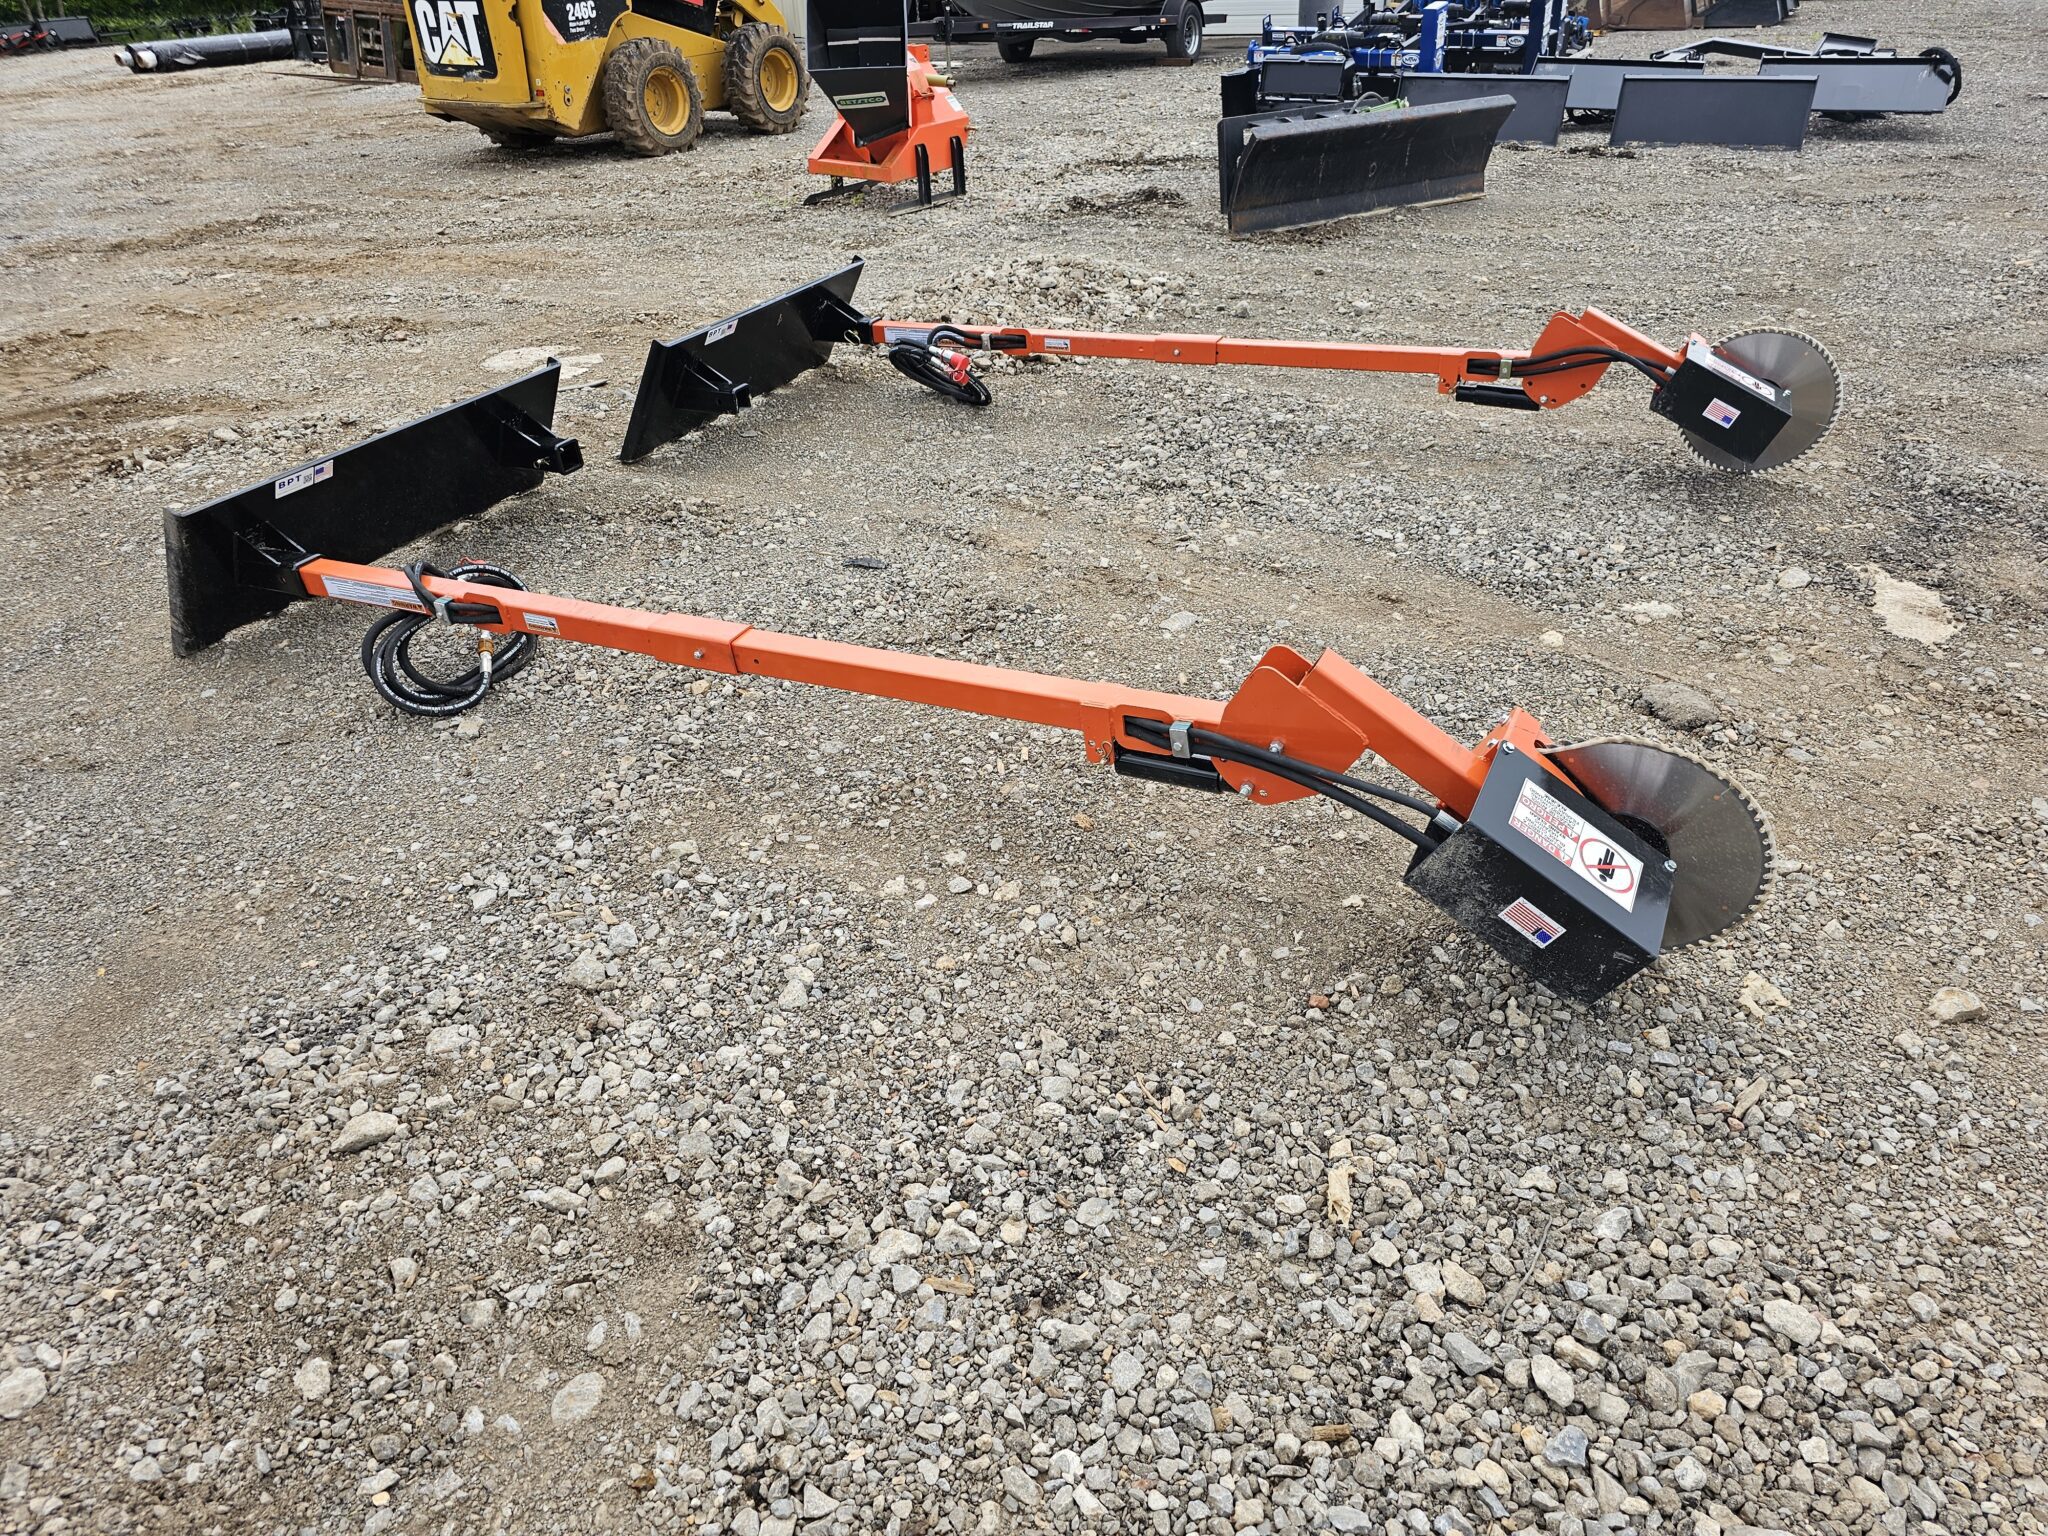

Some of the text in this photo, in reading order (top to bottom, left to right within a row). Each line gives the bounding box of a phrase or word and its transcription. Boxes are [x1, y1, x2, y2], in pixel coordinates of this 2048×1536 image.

[566, 0, 597, 21] 246C
[415, 0, 484, 66] CAT
[1012, 21, 1054, 30] TRAILSTAR
[708, 328, 722, 338] BPT
[278, 474, 302, 489] BPT
[1521, 795, 1565, 831] PELIGRO
[1512, 817, 1556, 852] DANGER
